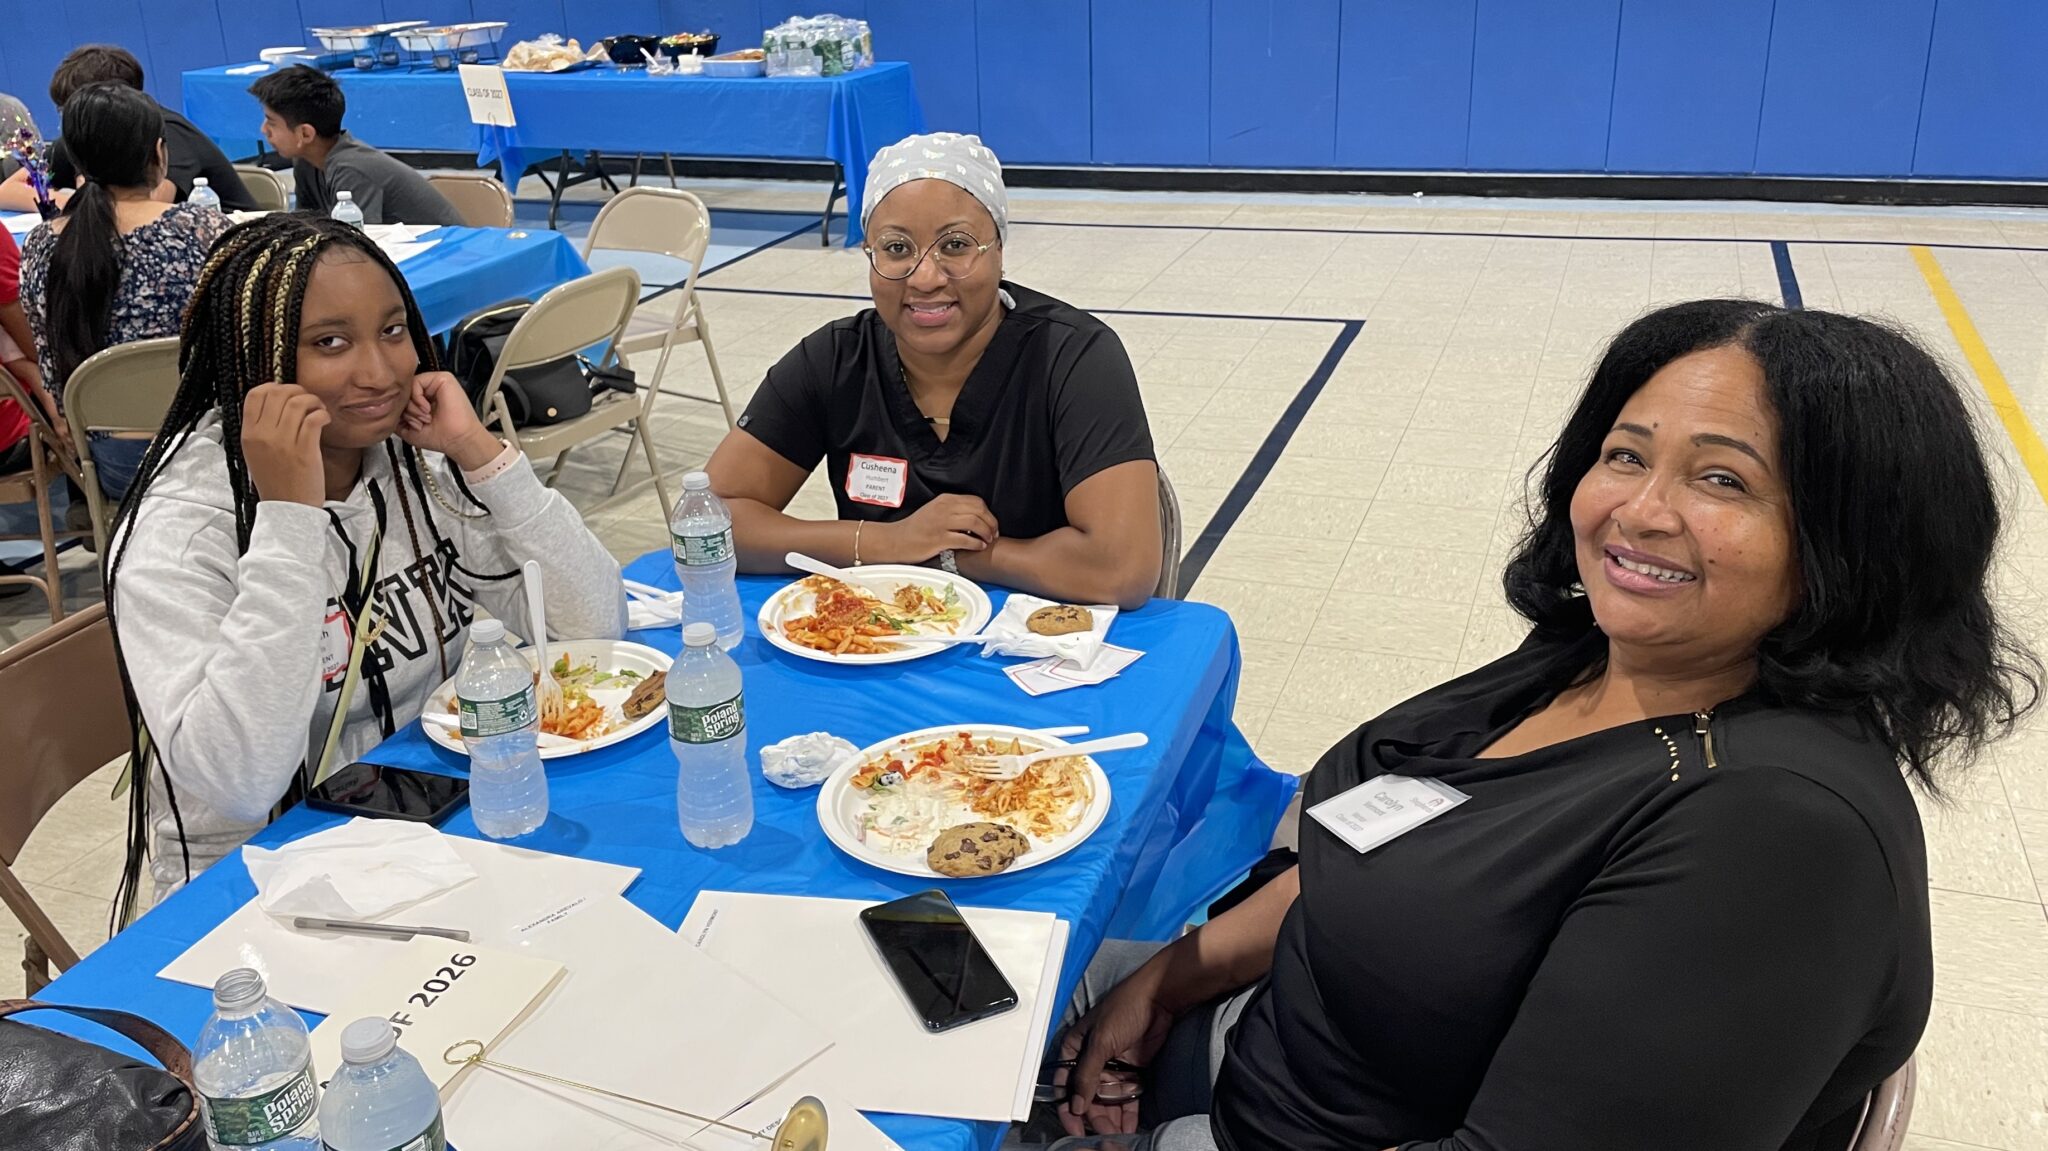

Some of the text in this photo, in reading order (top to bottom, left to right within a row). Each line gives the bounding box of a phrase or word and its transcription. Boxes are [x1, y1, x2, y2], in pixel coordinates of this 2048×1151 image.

[861, 461, 897, 474] Cusheena
[866, 484, 886, 492] PARENT
[701, 700, 738, 727] Poland
[705, 711, 739, 738] Spring
[408, 953, 477, 1008] 2026
[263, 1069, 311, 1122] Poland
[269, 1084, 314, 1134] Spring
